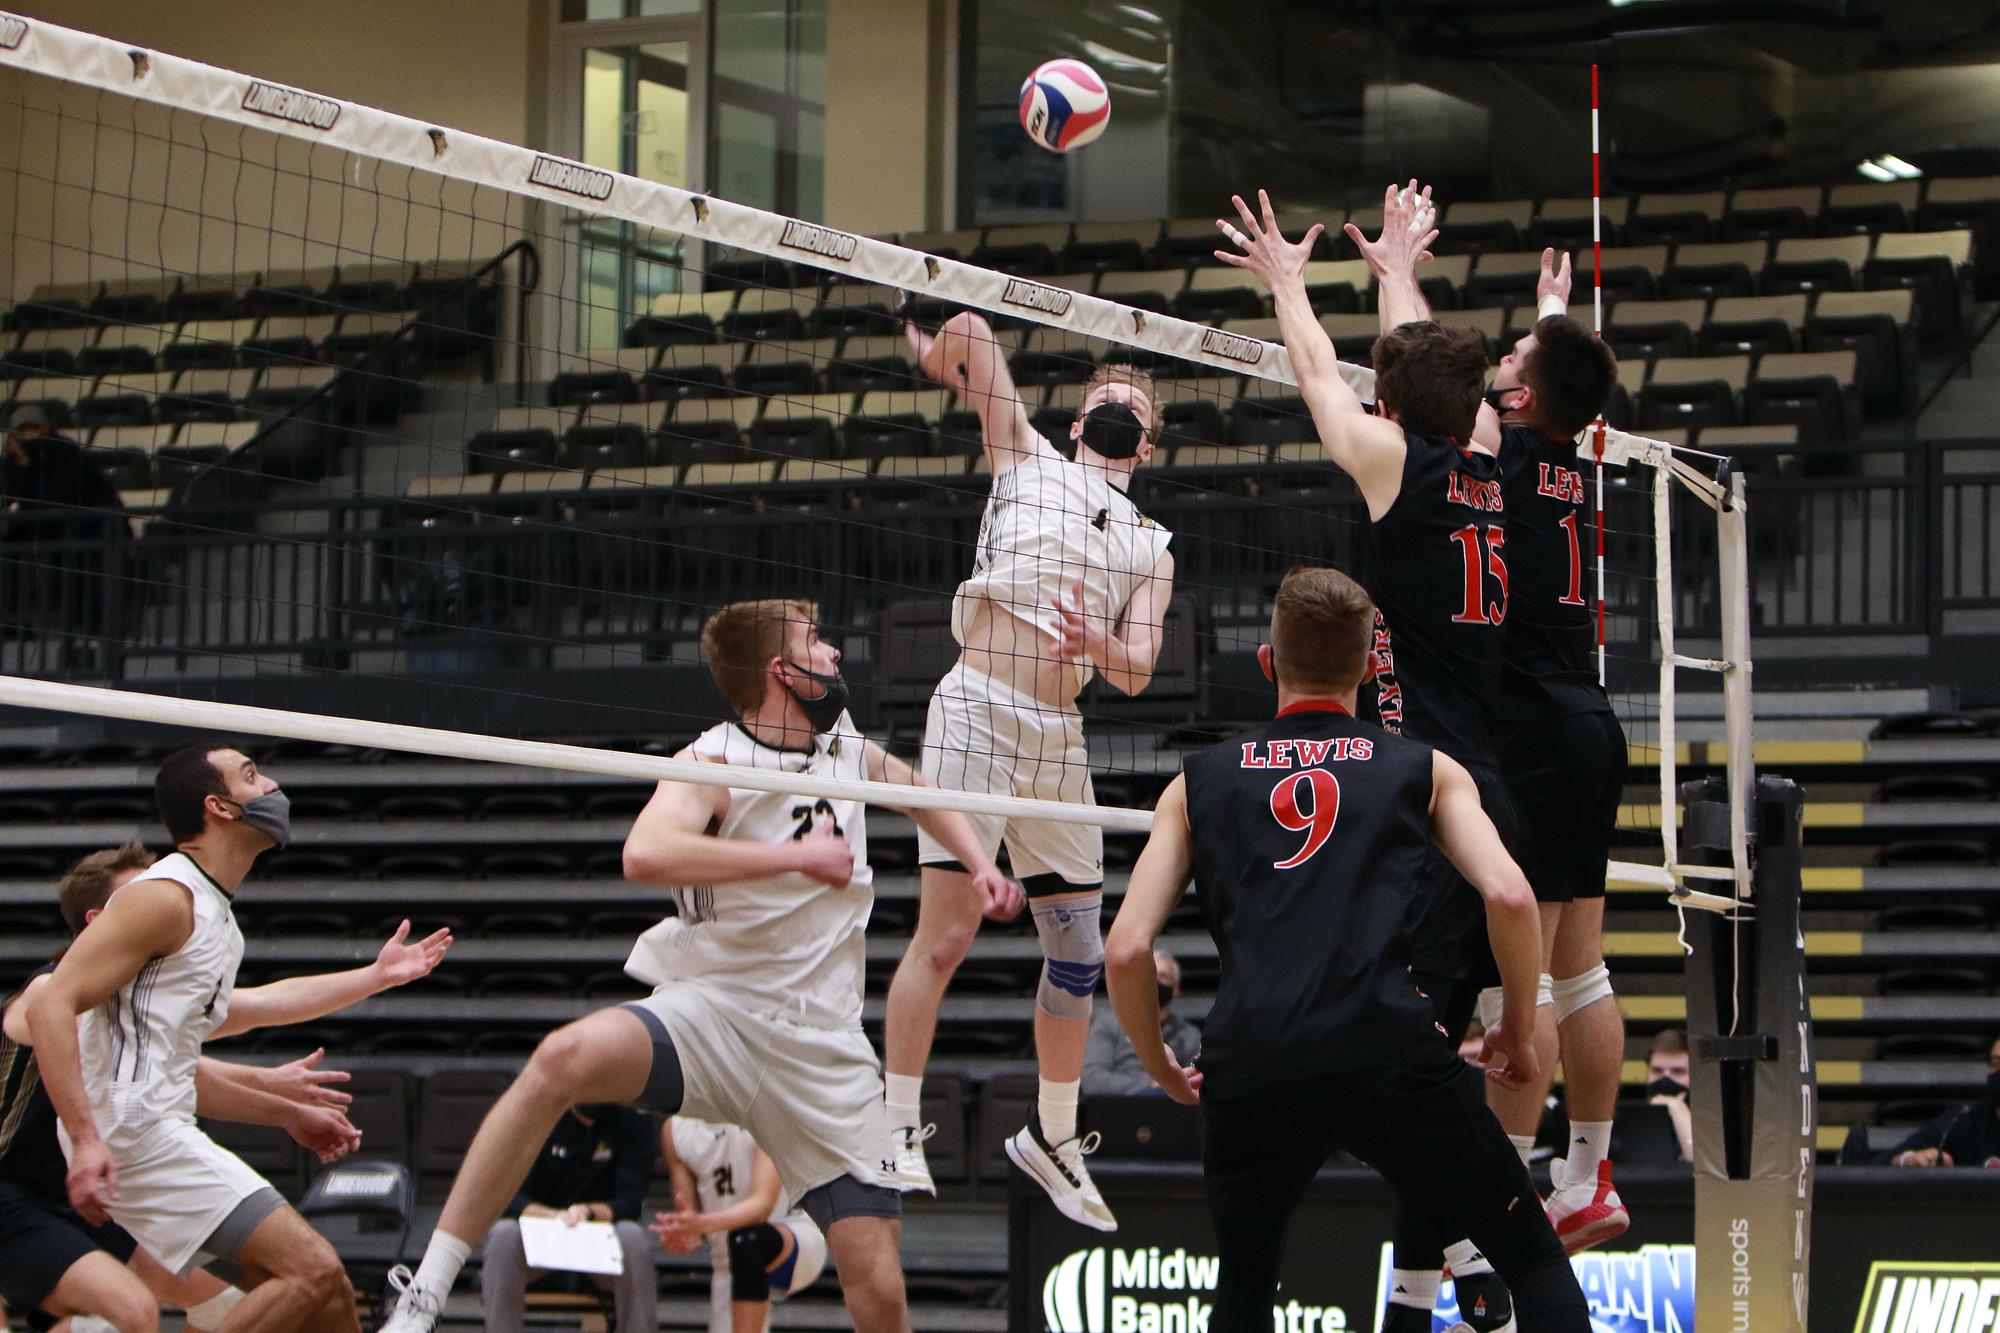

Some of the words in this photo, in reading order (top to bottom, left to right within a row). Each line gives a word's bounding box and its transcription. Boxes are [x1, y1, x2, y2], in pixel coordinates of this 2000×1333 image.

[242, 82, 341, 131] LINDENWOOD
[530, 156, 614, 201] LINDENWOOD
[780, 221, 857, 262] LINDENWOOD
[1002, 279, 1072, 316] LINDENWOOD
[1201, 329, 1263, 364] LINDENWOOD
[1450, 524, 1509, 626] 15
[1559, 508, 1585, 606] 1
[1240, 737, 1374, 769] LEWIS
[1270, 768, 1340, 869] 9
[1112, 1247, 1220, 1291] Midw
[1728, 1218, 1752, 1297] sports
[1732, 1300, 1750, 1333] im
